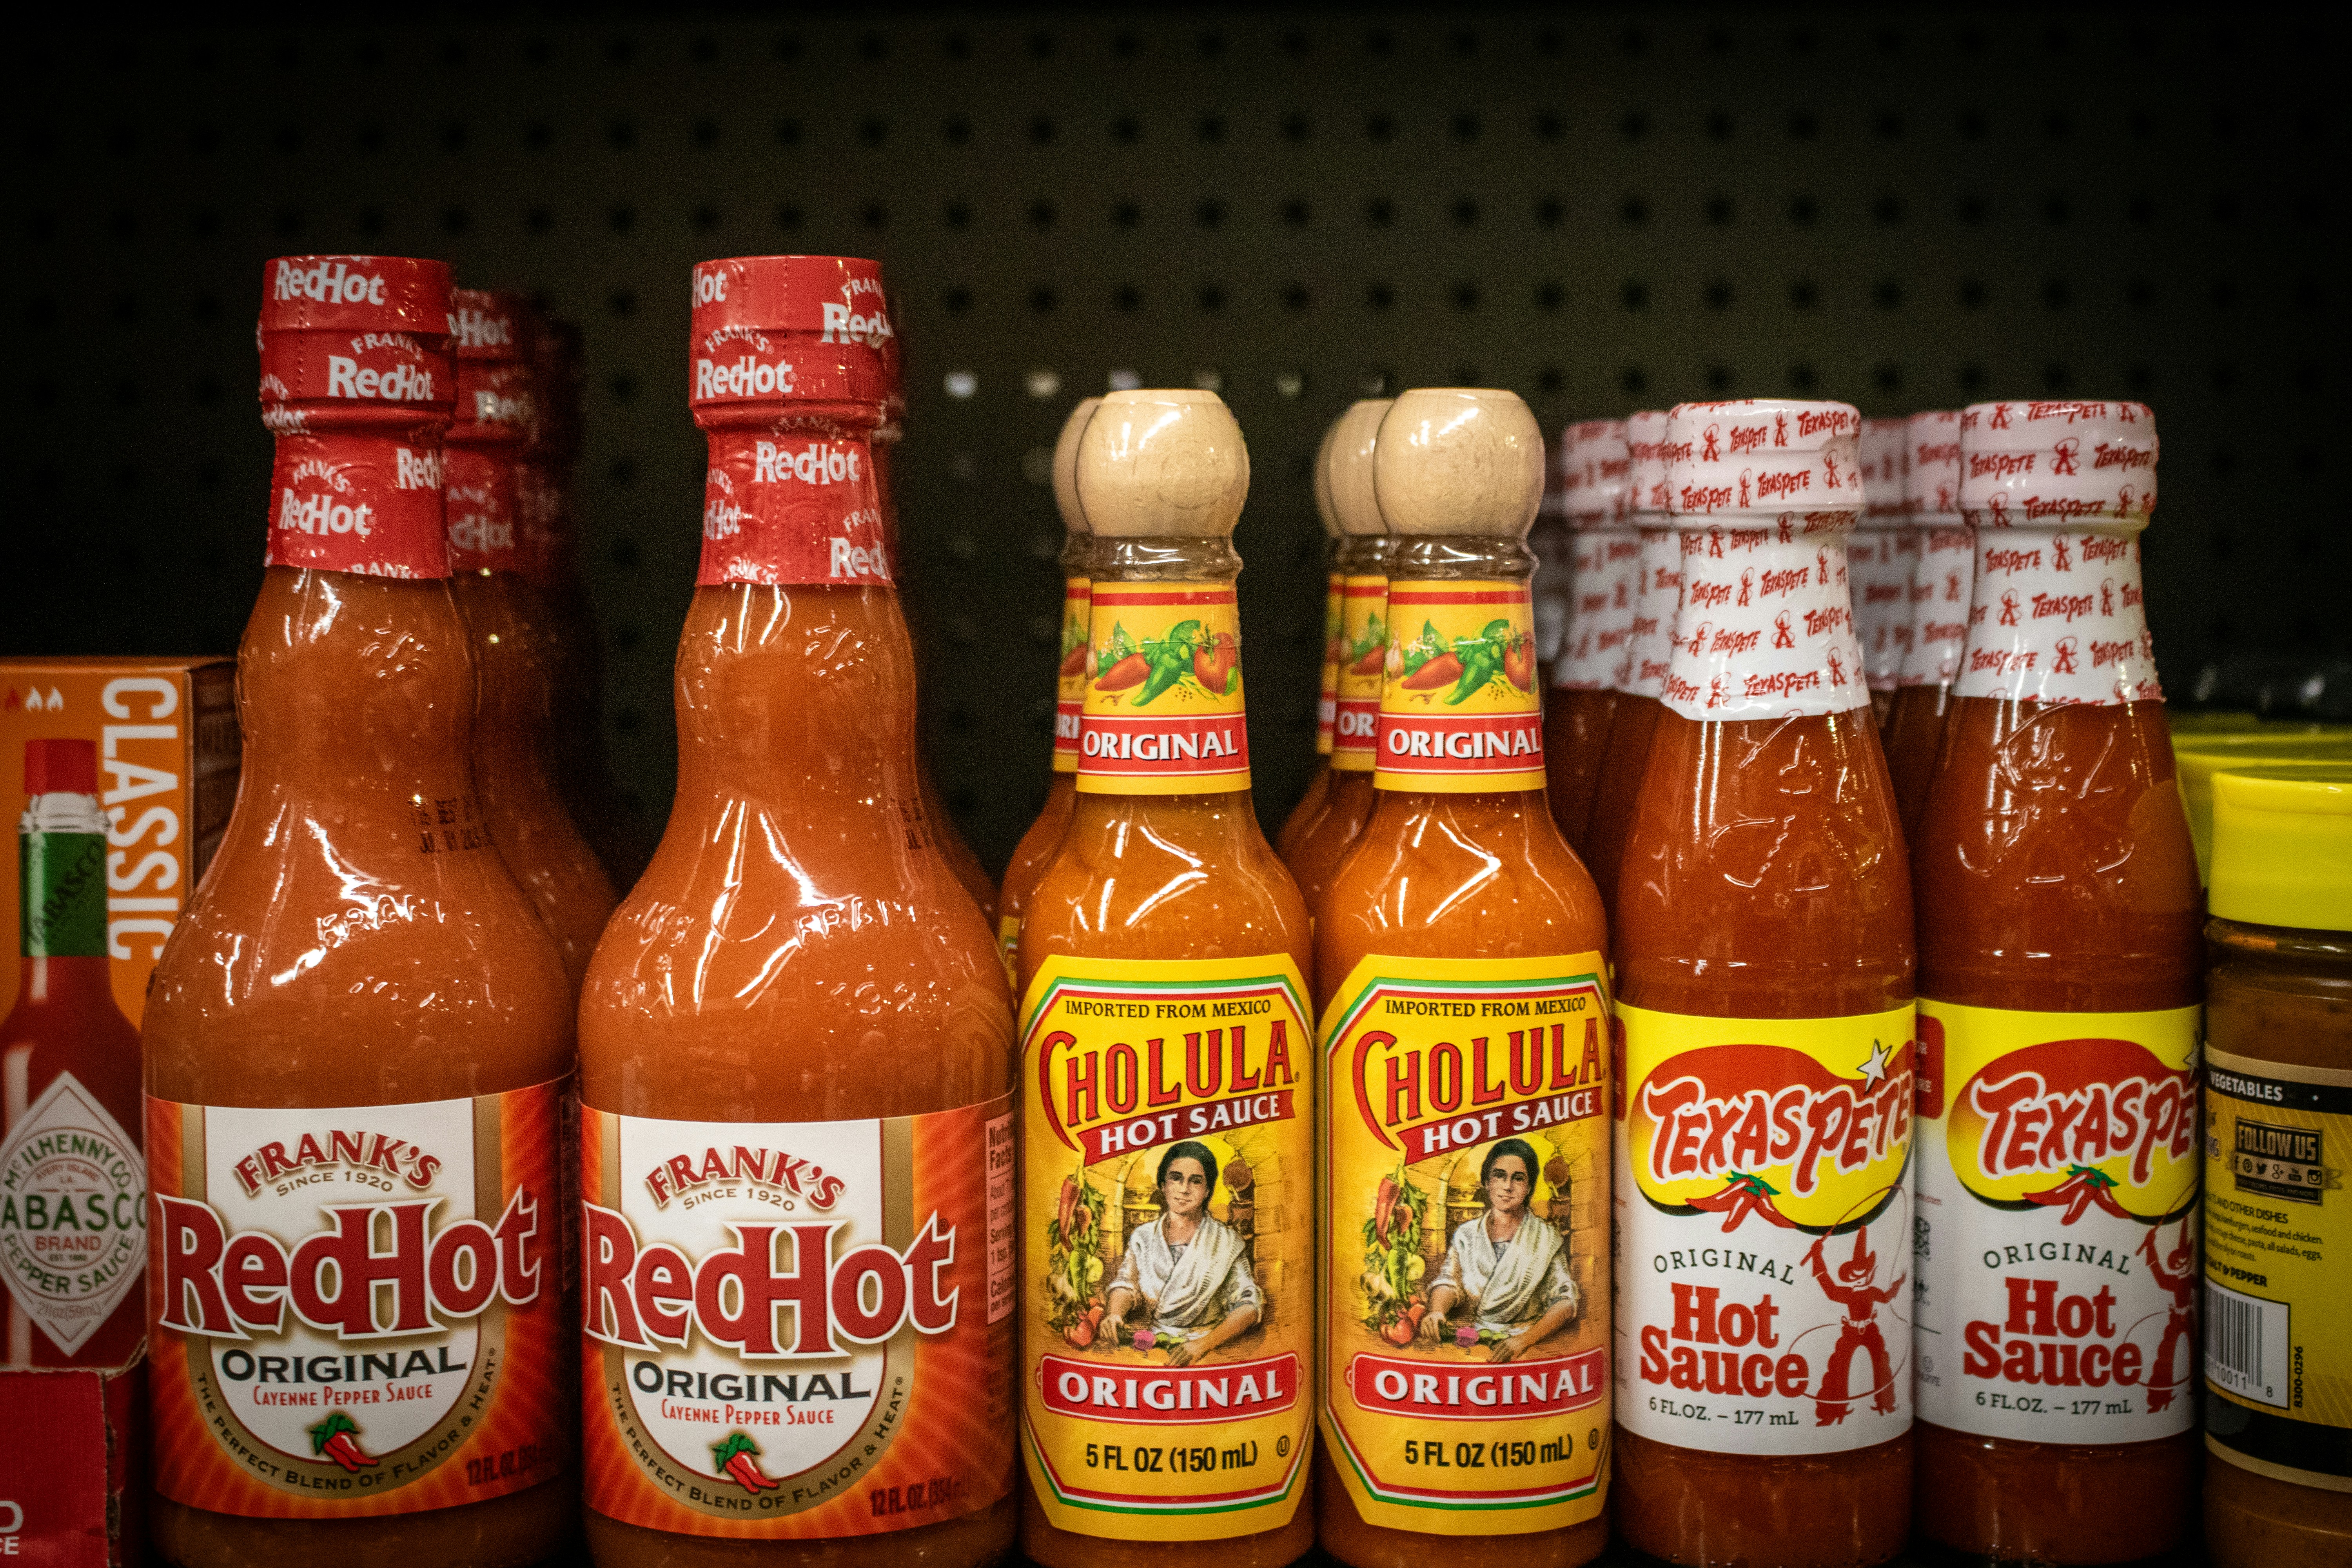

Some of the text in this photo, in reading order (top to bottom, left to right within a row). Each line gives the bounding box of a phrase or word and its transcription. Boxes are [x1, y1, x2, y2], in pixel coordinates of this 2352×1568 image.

[275, 260, 384, 305] RedHot
[693, 267, 727, 308] Hot
[458, 308, 512, 348] Hot
[328, 354, 434, 401] RedHot
[696, 355, 793, 399] RedHot
[755, 441, 860, 485] RedHot
[276, 487, 372, 536] RedHot
[1083, 730, 1239, 761] ORIGINAL
[1388, 728, 1541, 759] ORIGINAL
[102, 677, 180, 960] CLASSIC
[1065, 999, 1271, 1018] IMPORTED FROM MEXICO
[1385, 996, 1586, 1017] IMPORTED FROM MEXICO
[1039, 1019, 1295, 1152] CHOLULA
[1352, 1017, 1602, 1151] CHOLULA
[2209, 1070, 2283, 1102] VEGETABLES
[1101, 1094, 1280, 1155] HOT SAUCE
[1423, 1091, 1594, 1154] HOT SAUCE
[2238, 1124, 2292, 1158] FOLLOW
[2294, 1135, 2317, 1161] US
[234, 1129, 443, 1193] FRANK'S
[645, 1145, 846, 1210] FRANK'S
[277, 1170, 393, 1196] SINCE 1920
[683, 1188, 795, 1212] SINCE 1920
[2256, 1208, 2289, 1224] DISHES
[2278, 1229, 2292, 1240] and
[2292, 1231, 2324, 1245] chicken.
[4, 1234, 133, 1294] PEPPER SAUCE
[35, 1235, 102, 1252] BRAND
[155, 1182, 543, 1340] RedHot
[1983, 1242, 2131, 1276] ORIGINAL
[2301, 1249, 2323, 1261] eggs,
[582, 1209, 960, 1360] RedHot
[1654, 1249, 1795, 1286] ORIGINAL
[2230, 1266, 2268, 1288] PEPPER
[1671, 1282, 1780, 1349] Hot
[2004, 1276, 2117, 1339] Hot
[221, 1346, 467, 1384] ORIGINAL
[1640, 1324, 1809, 1399] Sauce
[1963, 1319, 2143, 1388] Sauce
[633, 1360, 871, 1402] ORIGINAL
[1058, 1370, 1284, 1410] ORIGINAL
[1374, 1363, 1595, 1406] ORIGINAL
[2294, 1346, 2303, 1408] 8300-0296
[1649, 1396, 1657, 1411] 6
[1734, 1411, 1764, 1425] 177
[1769, 1411, 1800, 1426] mL
[1975, 1391, 1986, 1406] 6
[2071, 1401, 2101, 1416] 177
[2105, 1399, 2133, 1415] mL
[197, 1372, 217, 1414] THE
[216, 1415, 280, 1478] PERFECT
[285, 1471, 352, 1490] BLEND
[359, 1472, 385, 1487] OF
[393, 1426, 461, 1479] FLAVOR
[461, 1416, 474, 1427] &
[611, 1381, 629, 1424] THE
[626, 1426, 685, 1492] PERFECT
[689, 1488, 753, 1511] BLEND
[759, 1492, 786, 1510] OF
[792, 1455, 863, 1503] FLAVOR
[864, 1443, 877, 1457] &
[1405, 1433, 1573, 1468] 5 FL OZ (150 mL)
[1086, 1440, 1258, 1473] 5 FL OZ (150 mL)
